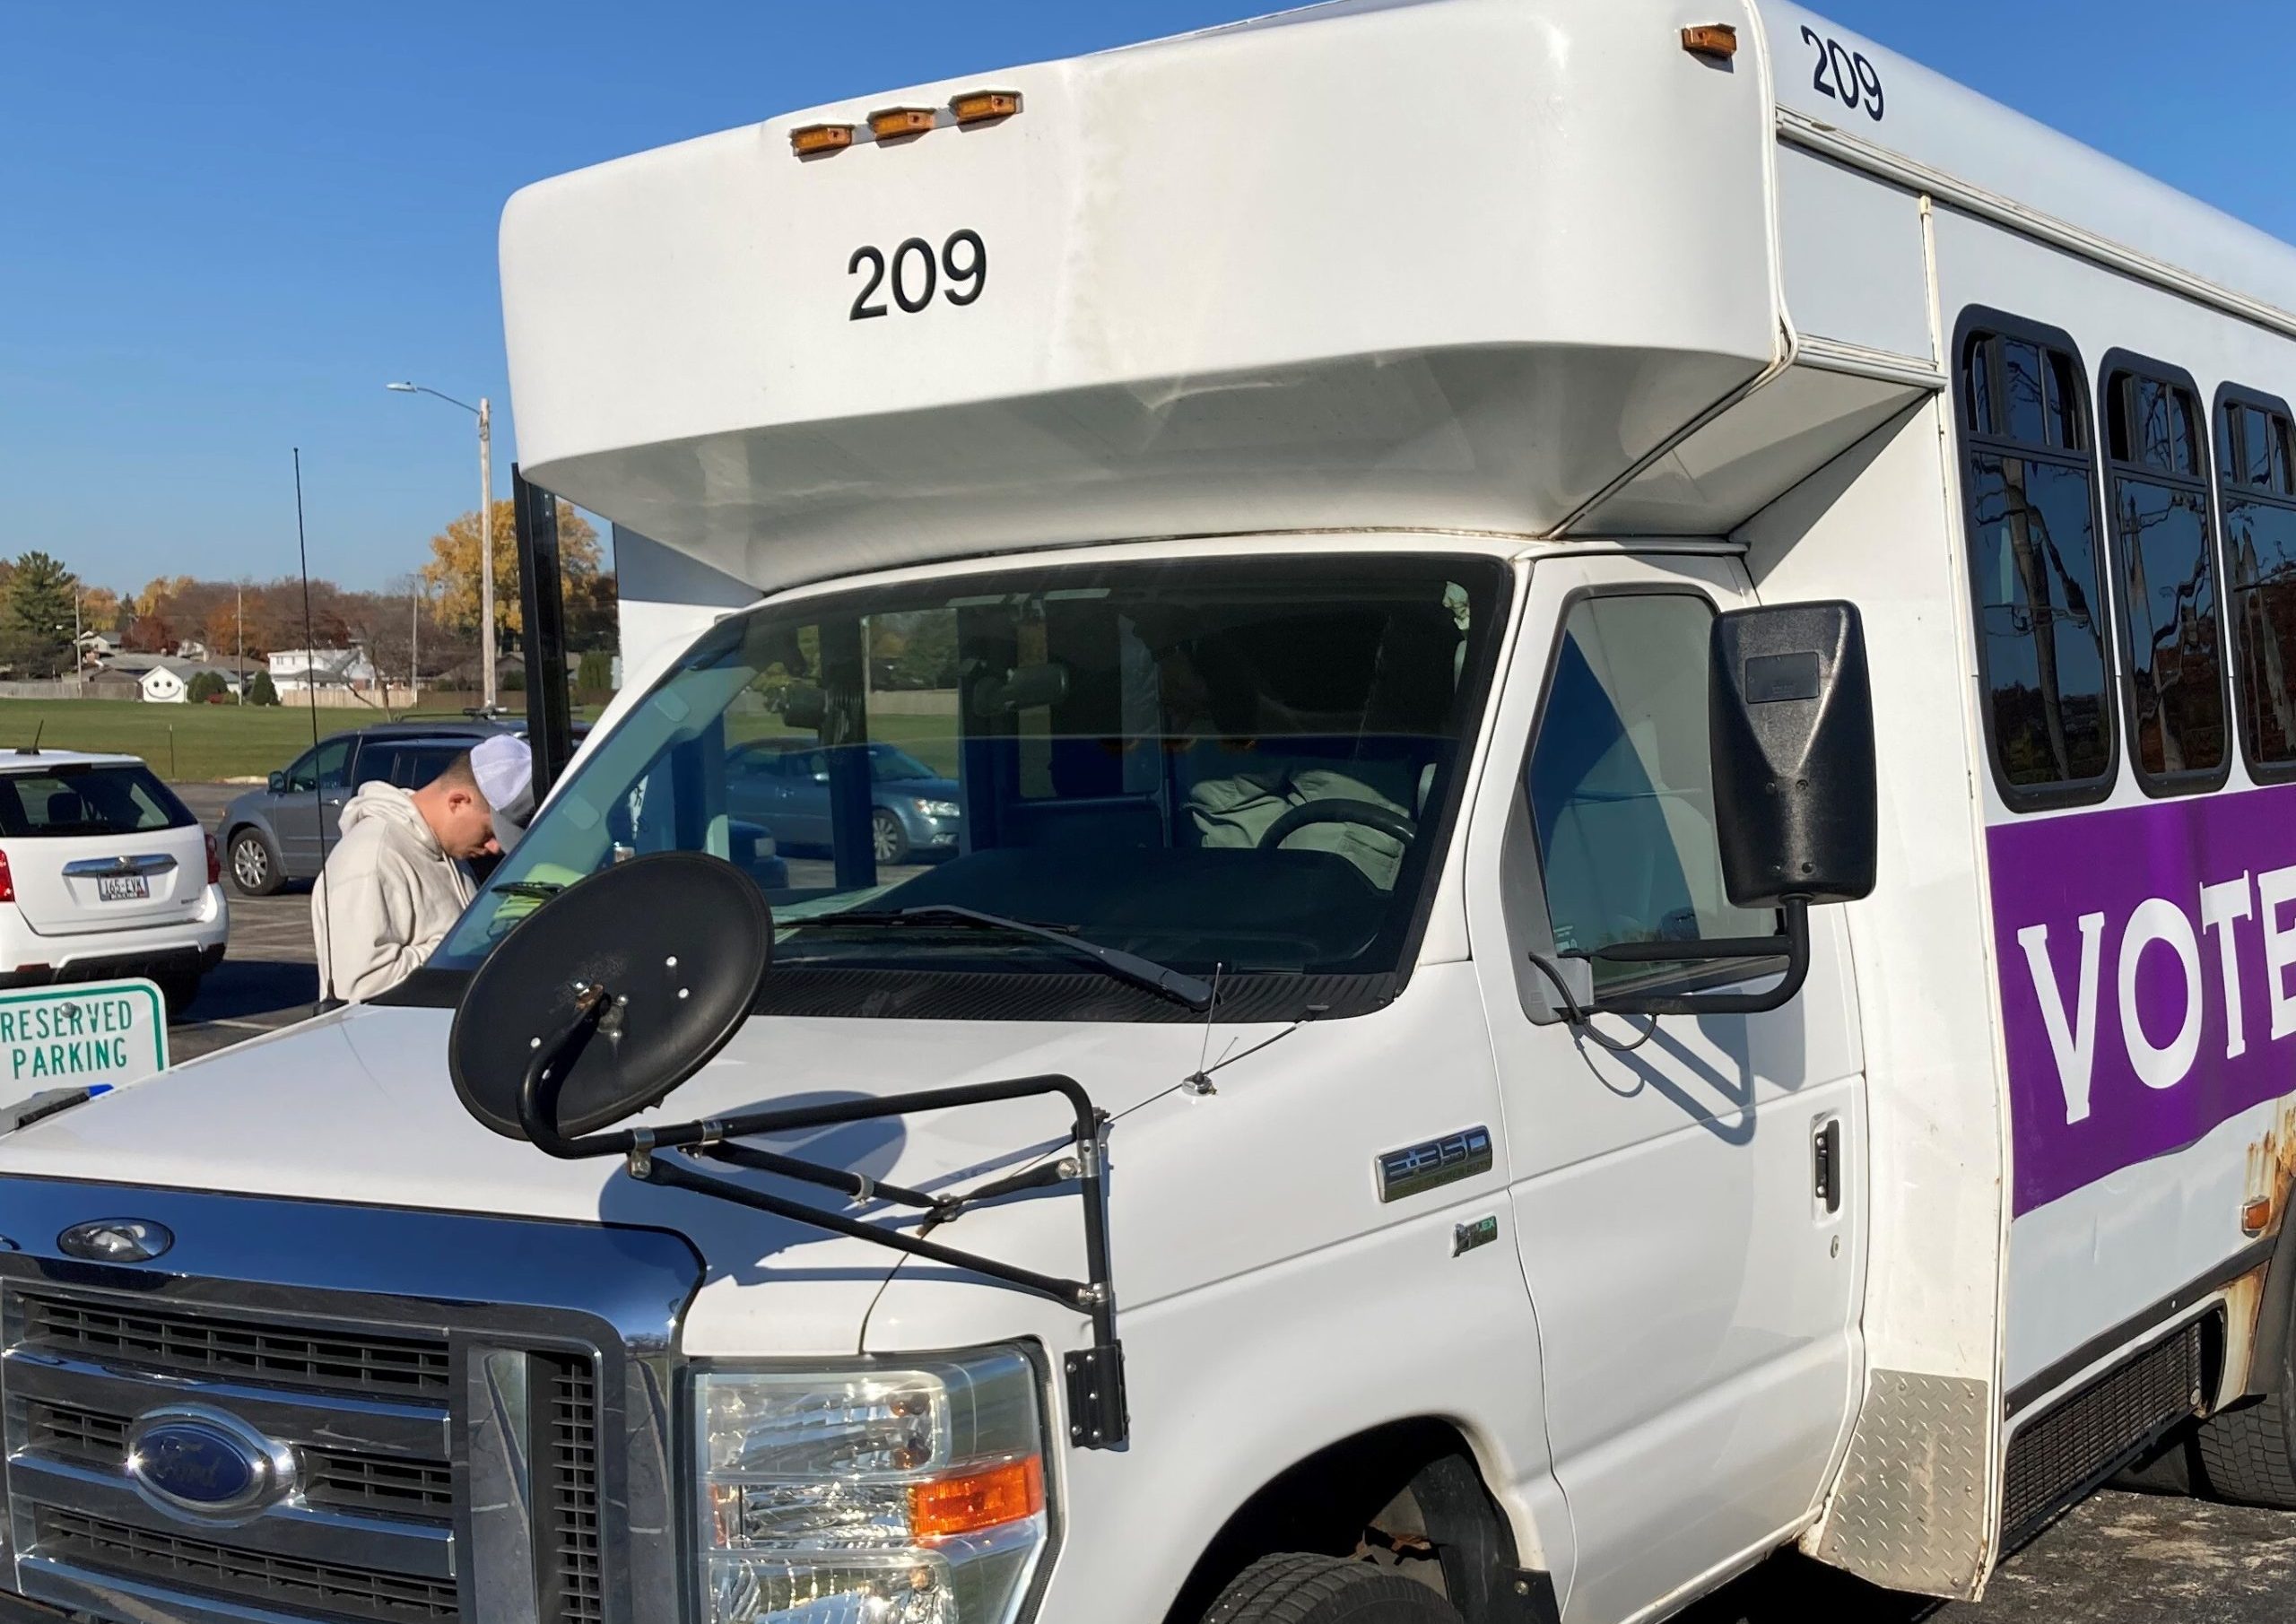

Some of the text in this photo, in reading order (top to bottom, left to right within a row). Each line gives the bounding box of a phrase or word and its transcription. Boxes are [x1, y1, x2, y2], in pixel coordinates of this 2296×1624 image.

[1800, 24, 1884, 122] 209
[848, 228, 987, 321] 209
[0, 1000, 133, 1043] RESERVED
[2017, 864, 2296, 1125] VOTE
[13, 1037, 127, 1080] PARKING
